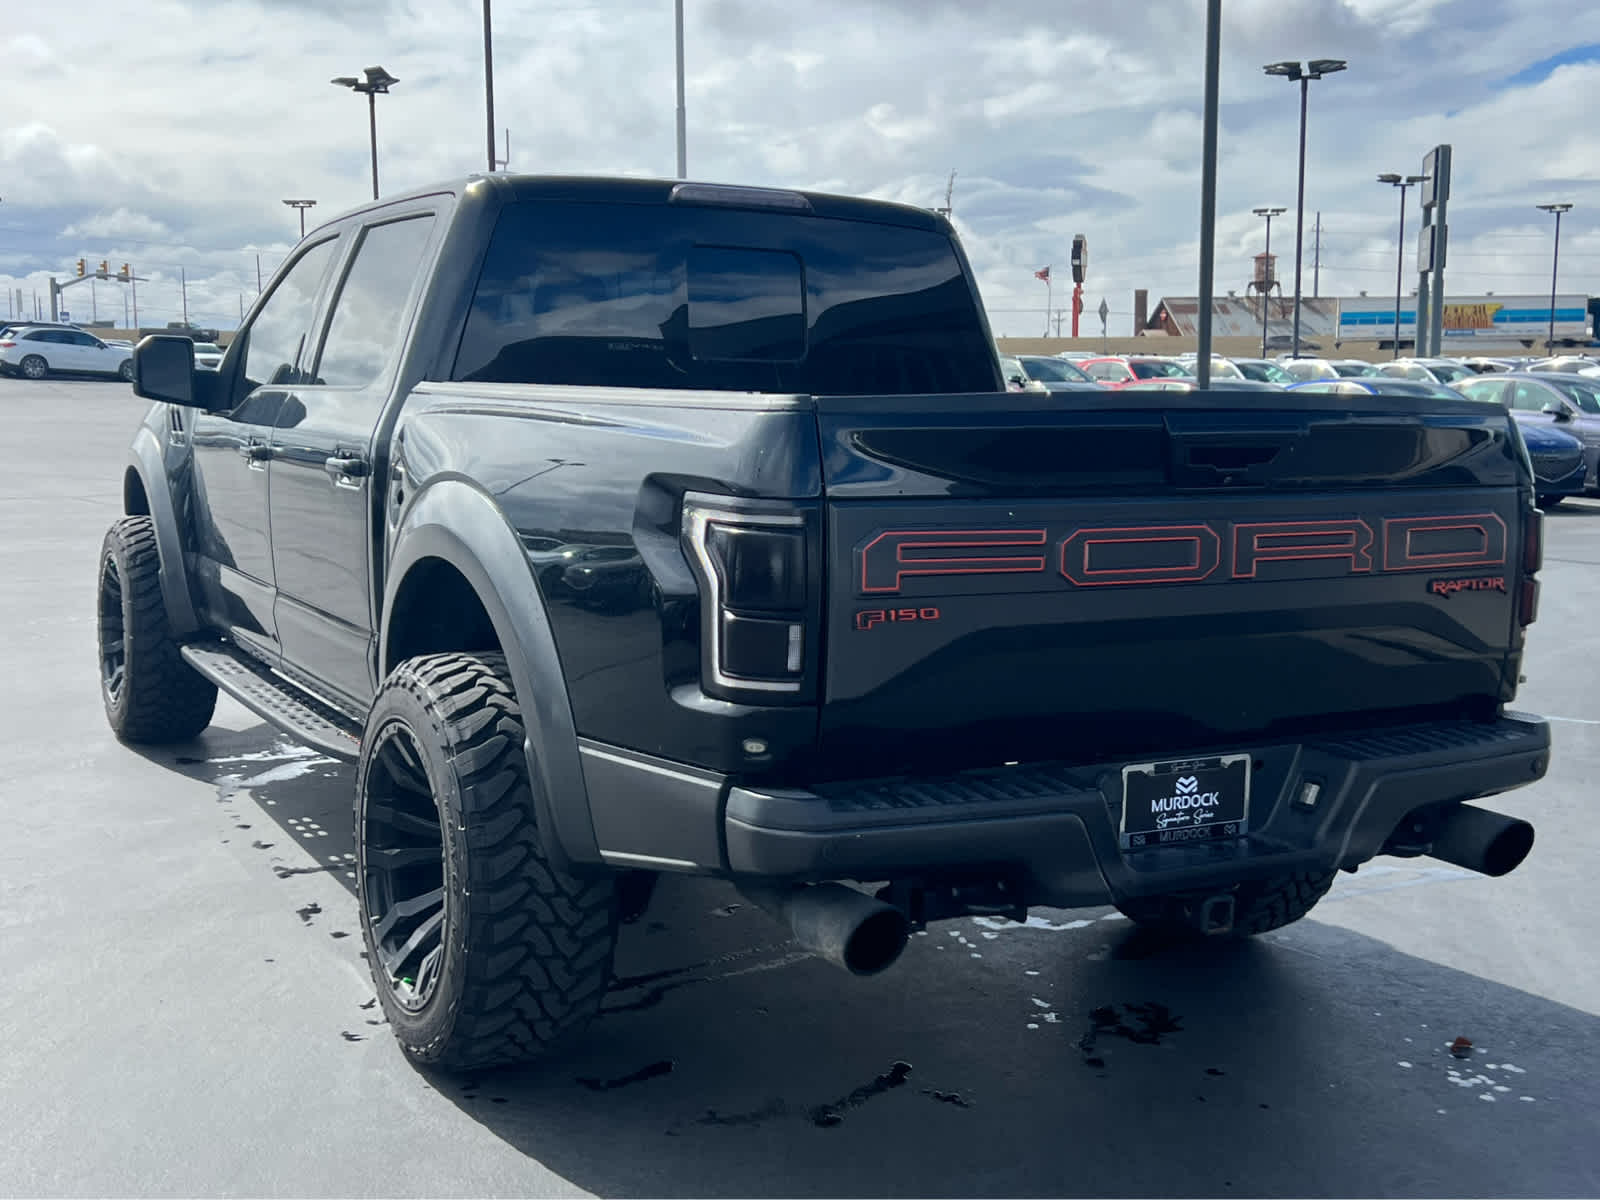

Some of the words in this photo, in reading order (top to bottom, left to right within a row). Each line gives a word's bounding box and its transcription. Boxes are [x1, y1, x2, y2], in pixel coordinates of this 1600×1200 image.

[861, 514, 1506, 592] FORD
[1431, 577, 1506, 595] RAPTOR
[1151, 792, 1219, 813] MURDOCK
